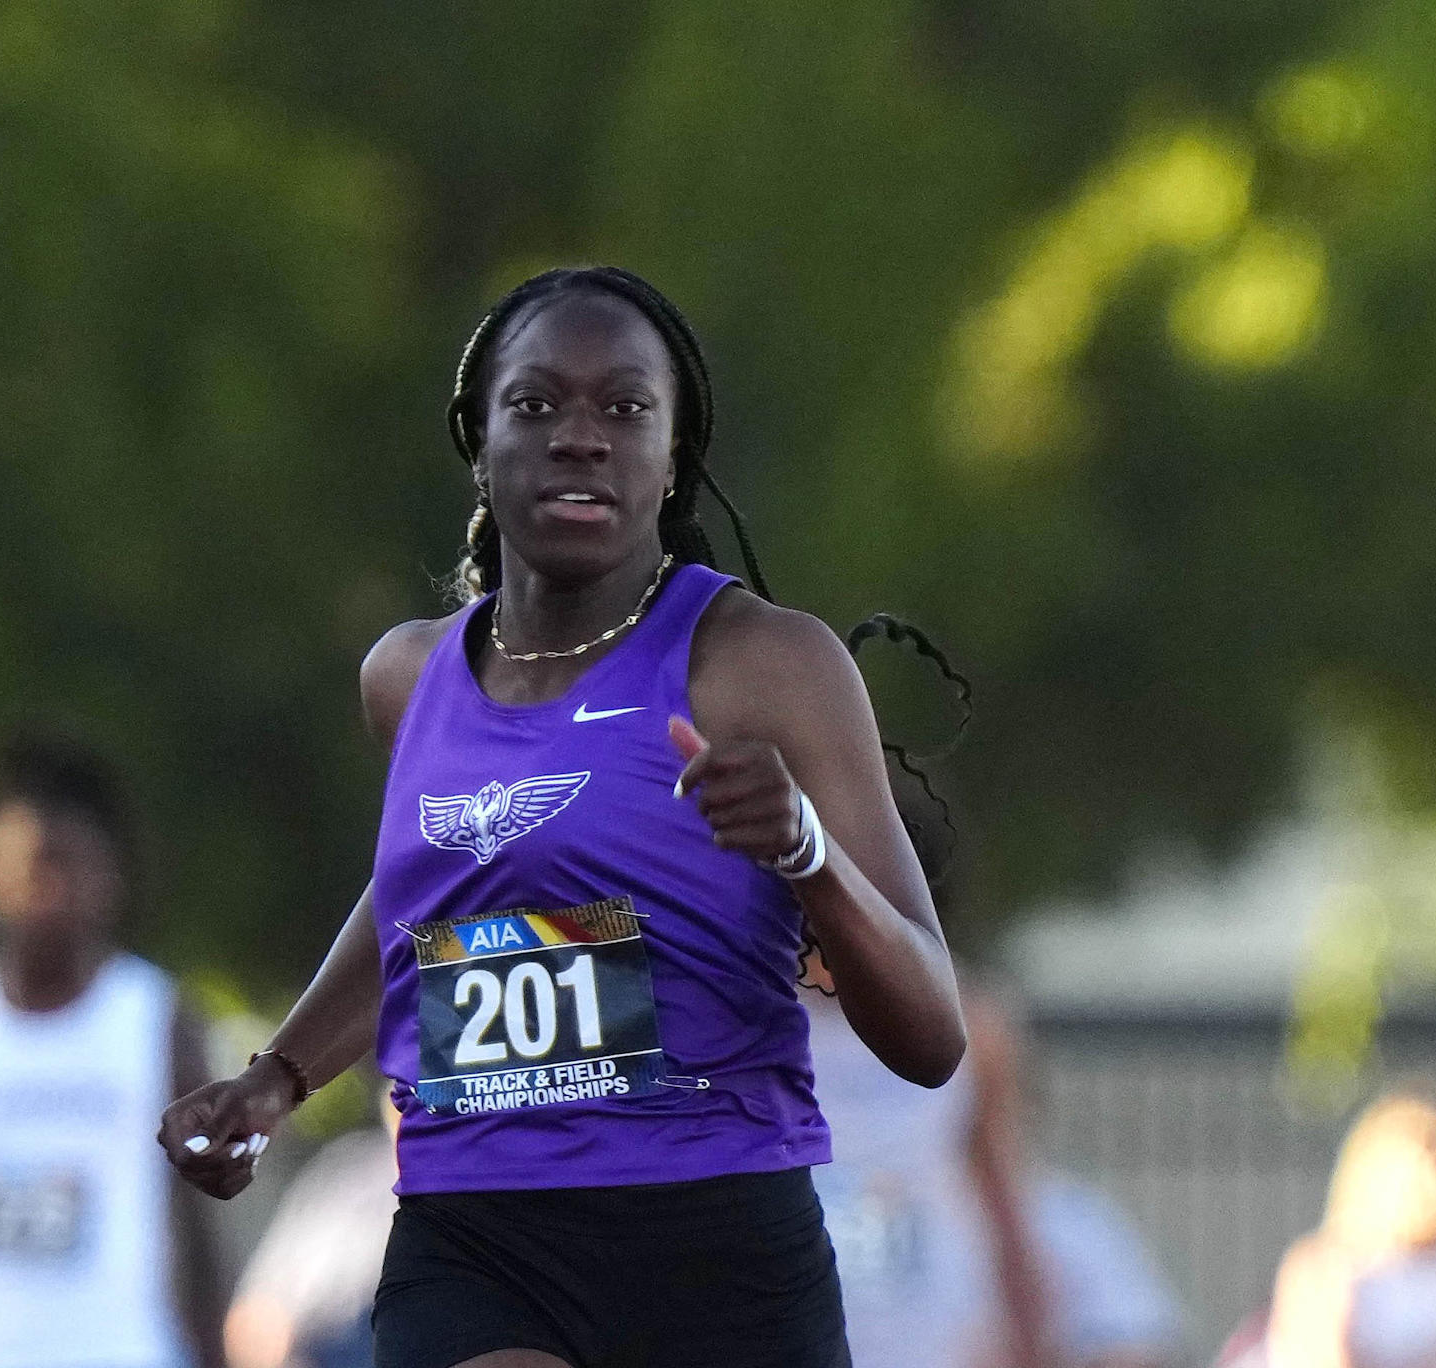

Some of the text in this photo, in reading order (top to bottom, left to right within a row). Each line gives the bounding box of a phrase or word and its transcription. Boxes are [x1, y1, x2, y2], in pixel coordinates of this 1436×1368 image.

[468, 922, 523, 952] AIA
[453, 954, 603, 1065] 201
[455, 1076, 630, 1115] CHAMPIONSHIPS
[462, 1060, 616, 1096] TRACK & FIELD
